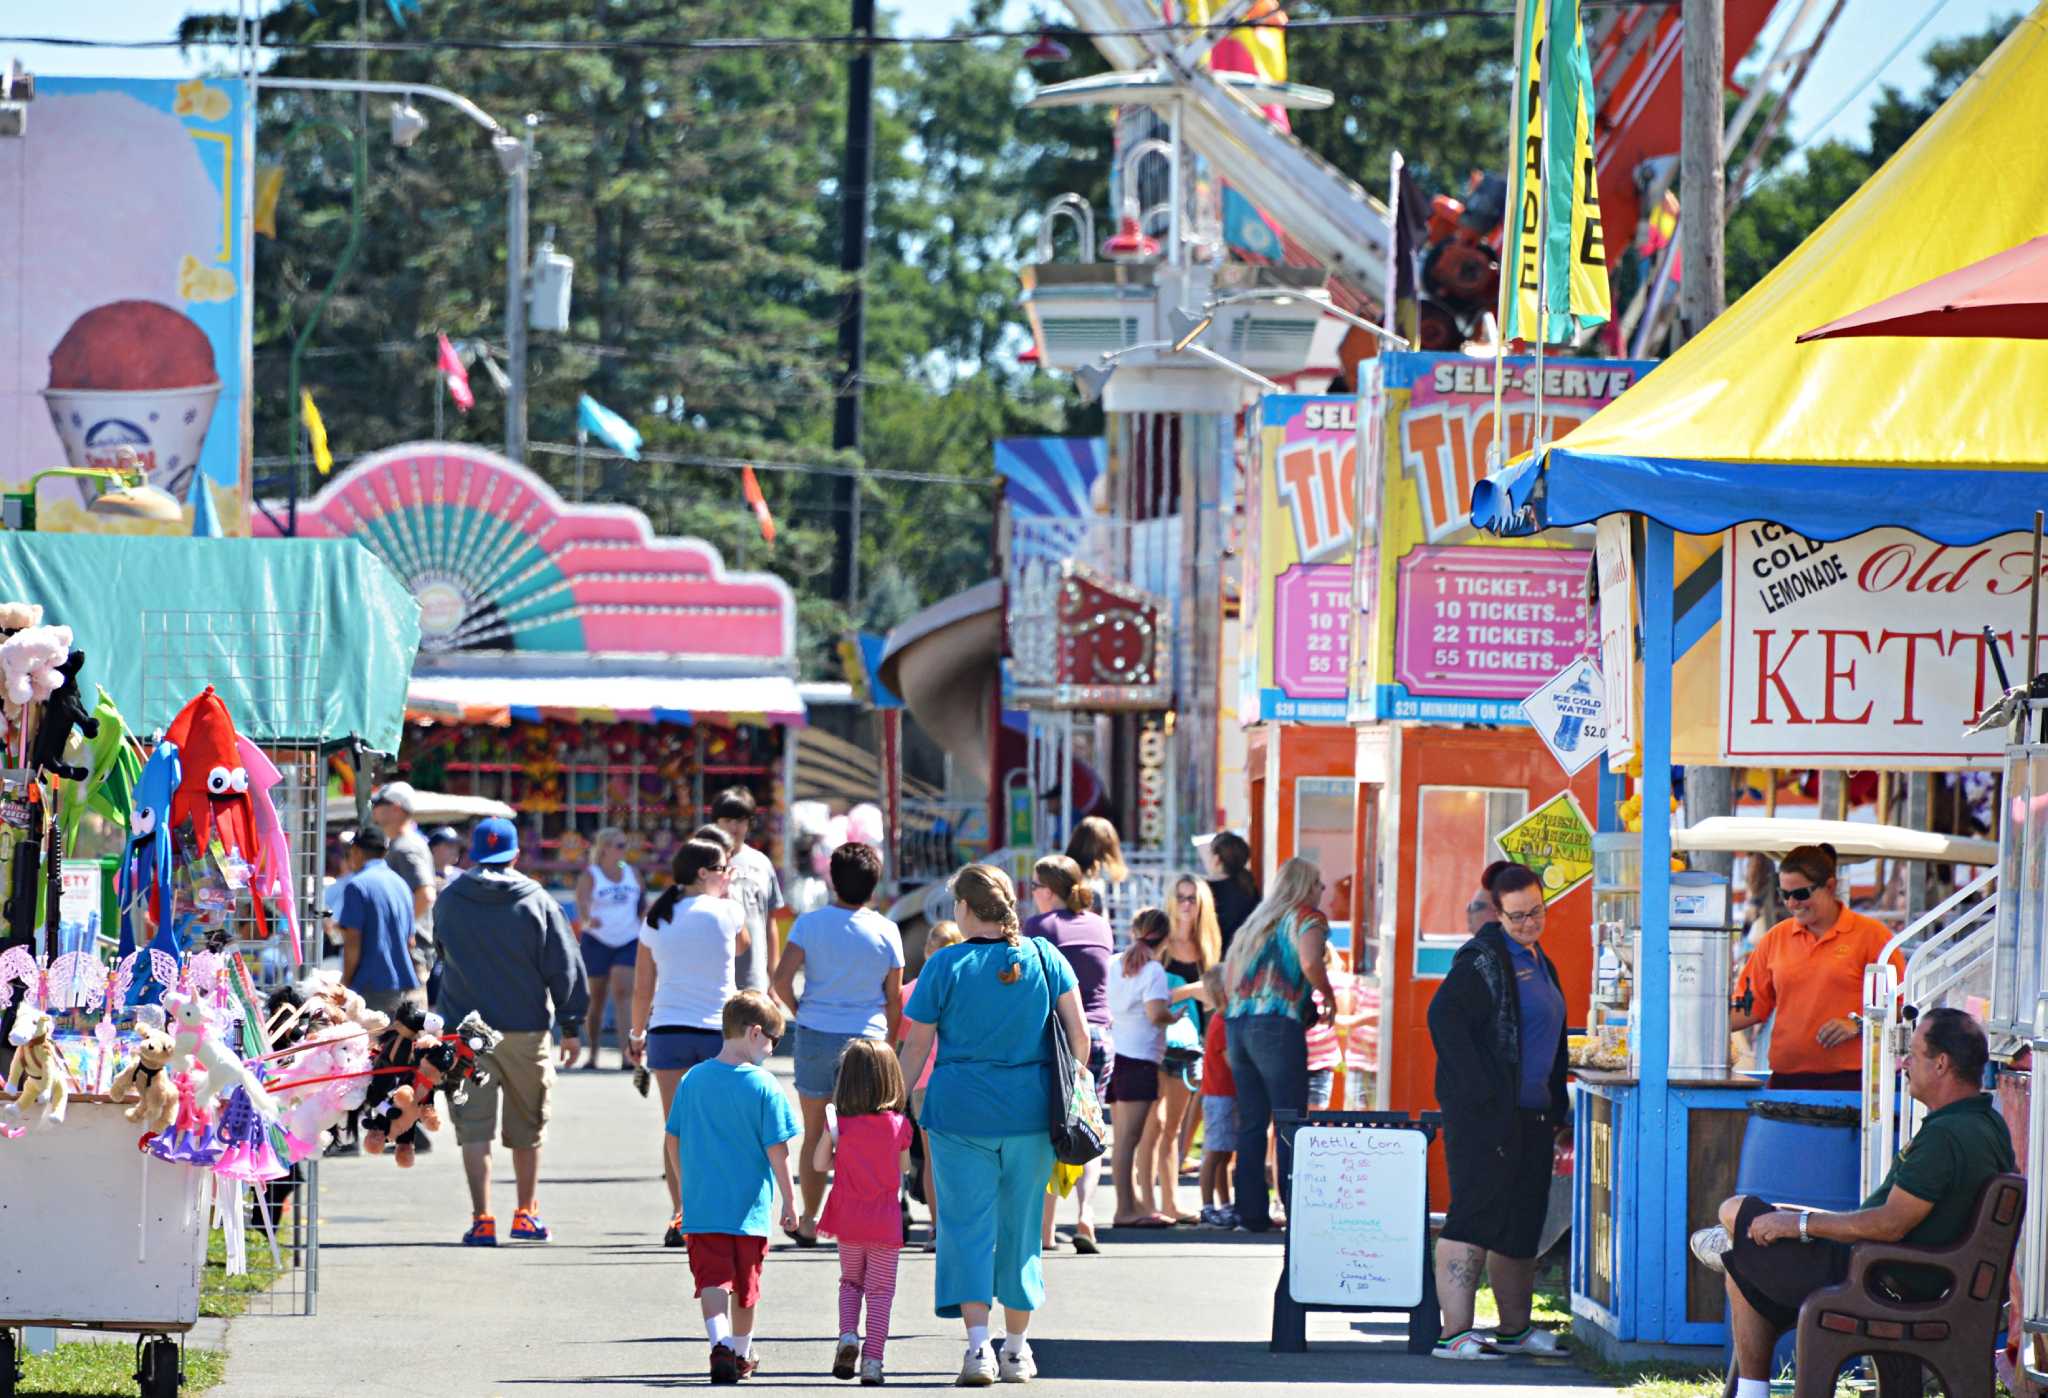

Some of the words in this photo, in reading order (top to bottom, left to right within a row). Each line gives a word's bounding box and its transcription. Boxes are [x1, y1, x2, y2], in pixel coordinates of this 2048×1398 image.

[1751, 522, 1793, 548] IC
[1752, 536, 1825, 578] COLD
[1857, 543, 1992, 593] Old
[1435, 577, 1446, 594] 1
[1759, 553, 1848, 614] LEMONADE
[1309, 592, 1319, 608] 1
[1434, 601, 1461, 619] 10
[1309, 613, 1332, 629] 10
[1307, 635, 1332, 651] 22
[1433, 626, 1460, 643] 22
[1435, 650, 1459, 665] 55
[1553, 694, 1570, 703] ICE
[1572, 697, 1602, 708] COLD
[1557, 703, 1597, 716] WATER
[1394, 701, 1418, 716] $20
[1420, 702, 1478, 718] MINIMUM
[1480, 703, 1499, 720] ON
[1310, 1135, 1358, 1150] Kettle
[1367, 1135, 1401, 1150] Corn
